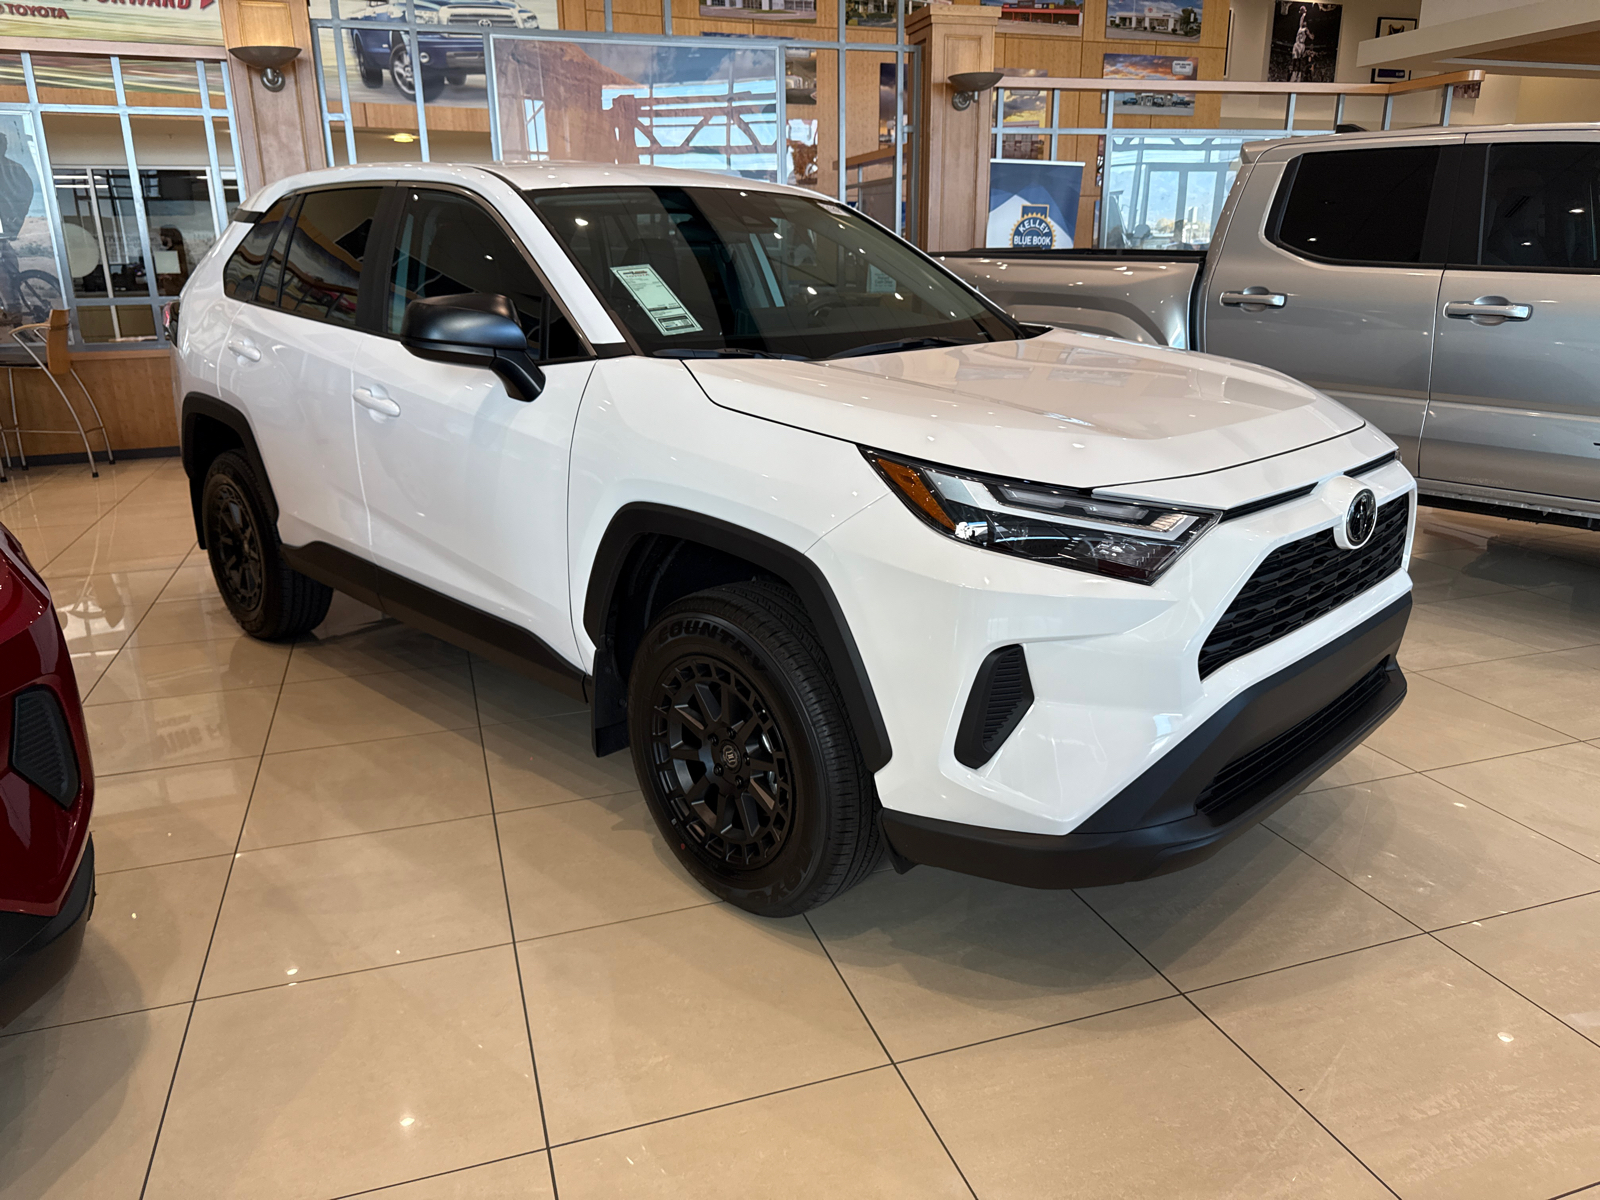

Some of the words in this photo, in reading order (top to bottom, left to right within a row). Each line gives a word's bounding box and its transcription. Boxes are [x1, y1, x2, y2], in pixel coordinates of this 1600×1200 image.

[4, 3, 70, 20] TOYOTA
[1018, 219, 1050, 234] KELLEY
[1013, 235, 1031, 245] BLUE
[1033, 235, 1051, 245] BOOK
[658, 619, 770, 672] COUNTRY
